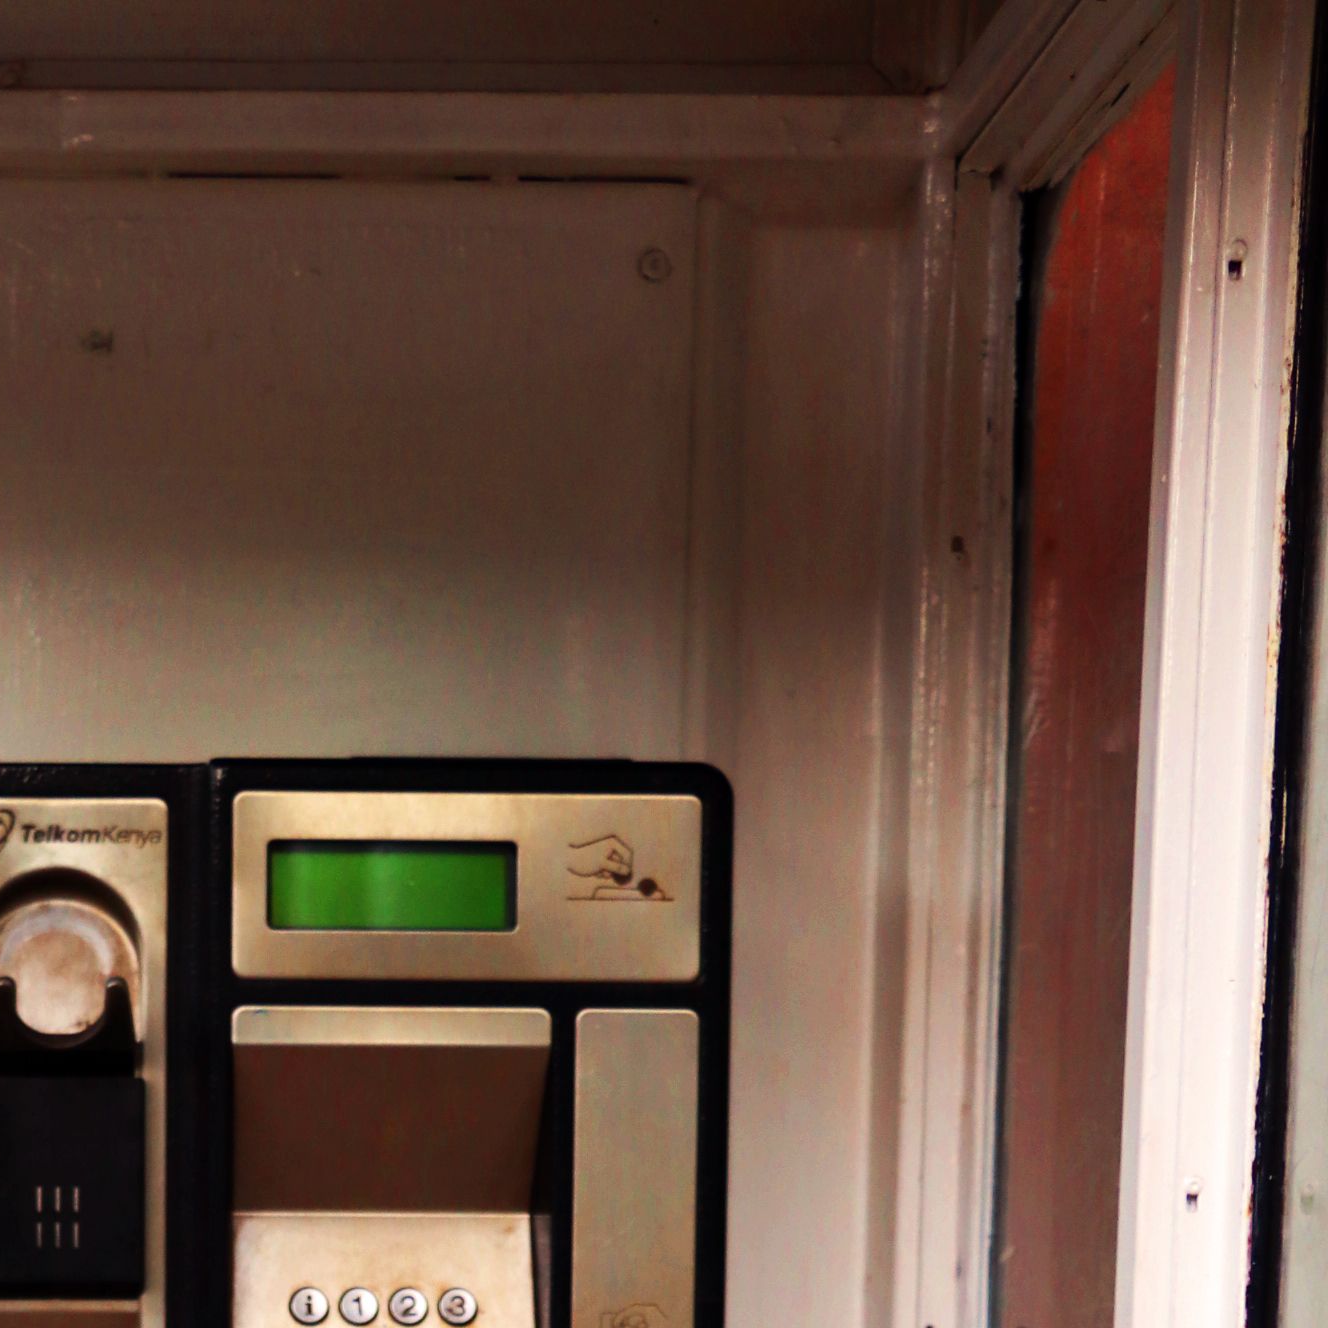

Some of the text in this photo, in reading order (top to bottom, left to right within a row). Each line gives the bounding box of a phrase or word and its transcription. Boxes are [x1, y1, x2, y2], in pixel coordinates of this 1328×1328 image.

[22, 824, 163, 849] TelkomKenya
[352, 1295, 364, 1317] 1
[399, 1295, 417, 1318] 2
[447, 1295, 465, 1318] 3
